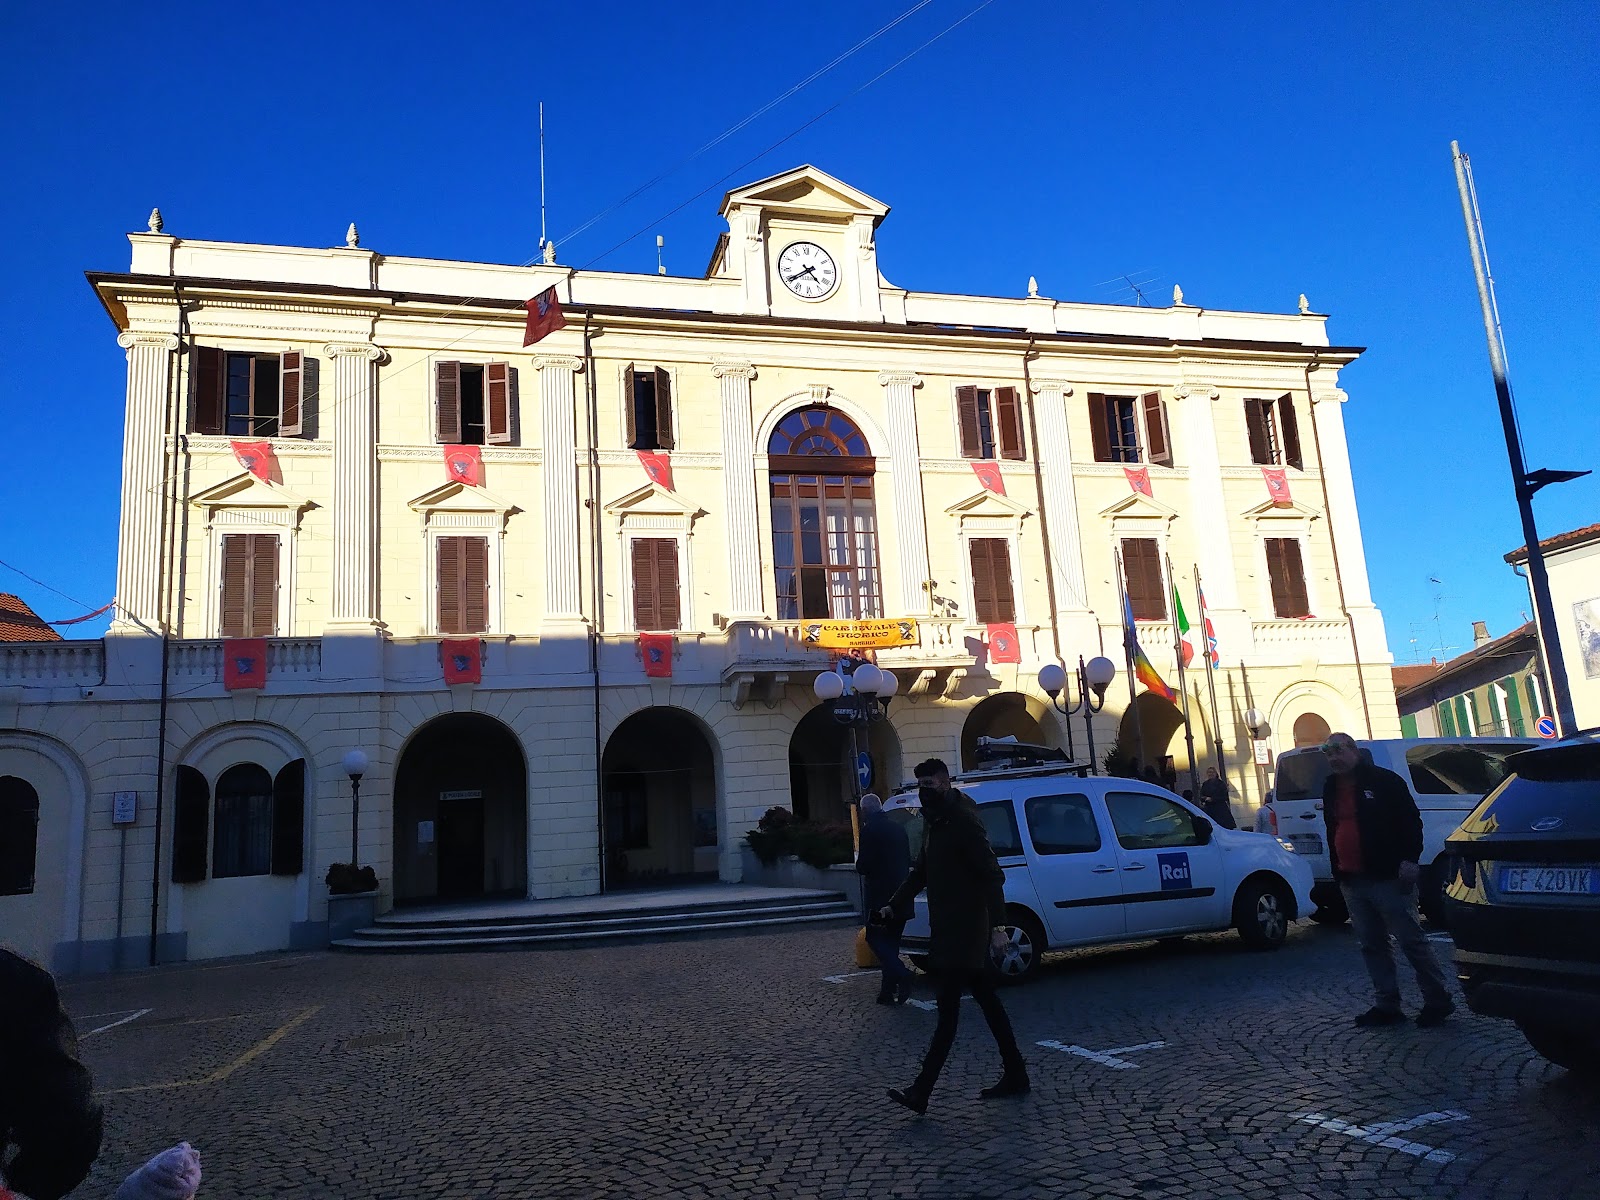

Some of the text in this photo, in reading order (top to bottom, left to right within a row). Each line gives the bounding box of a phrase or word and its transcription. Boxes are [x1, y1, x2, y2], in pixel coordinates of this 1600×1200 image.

[823, 623, 896, 631] CARNEVALE
[836, 631, 889, 639] STORICO
[1161, 862, 1189, 880] Rai
